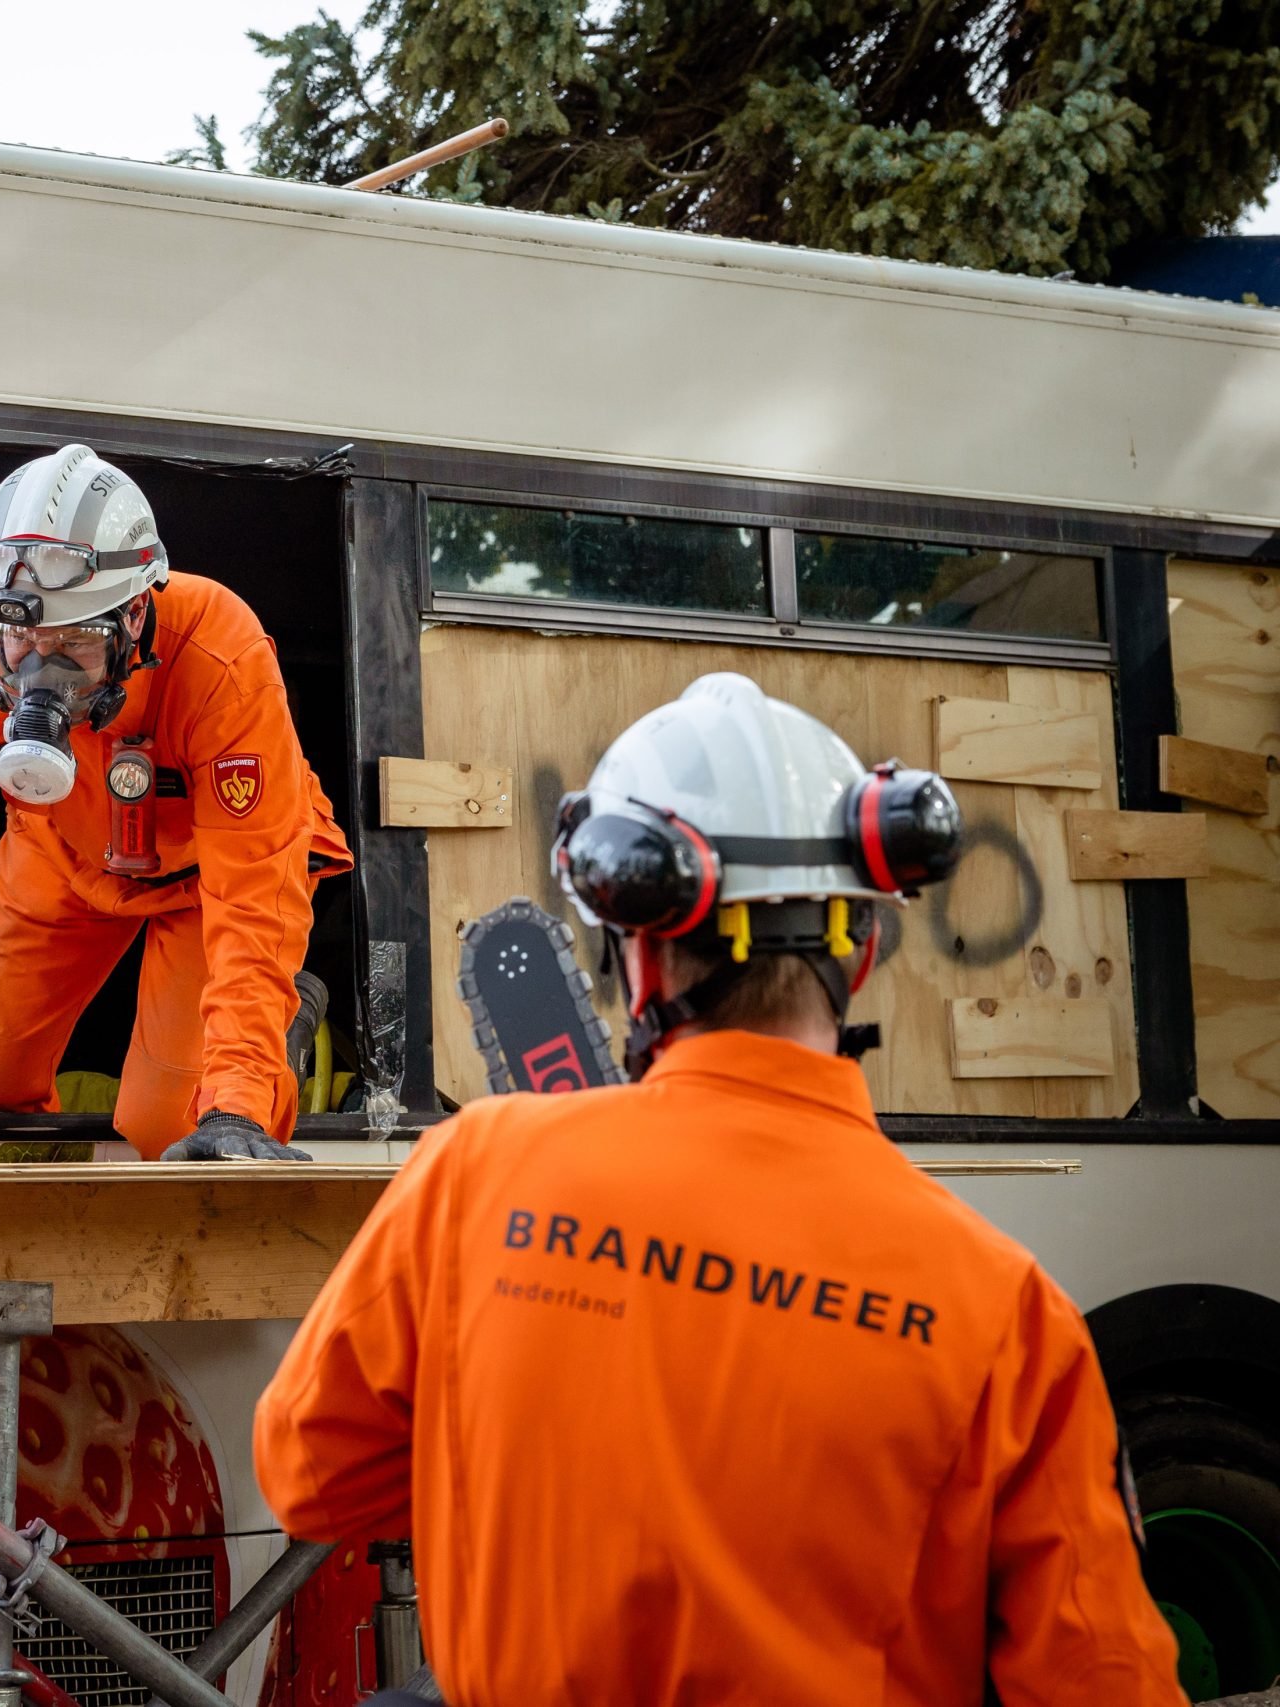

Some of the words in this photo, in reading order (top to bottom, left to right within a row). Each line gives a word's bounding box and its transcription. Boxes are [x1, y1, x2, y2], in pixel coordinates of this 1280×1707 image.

[90, 470, 120, 498] STH
[128, 521, 149, 543] Mart
[217, 759, 256, 769] BRANDWEER
[504, 1209, 939, 1345] BRANDWEER
[494, 1276, 627, 1320] Nederland
